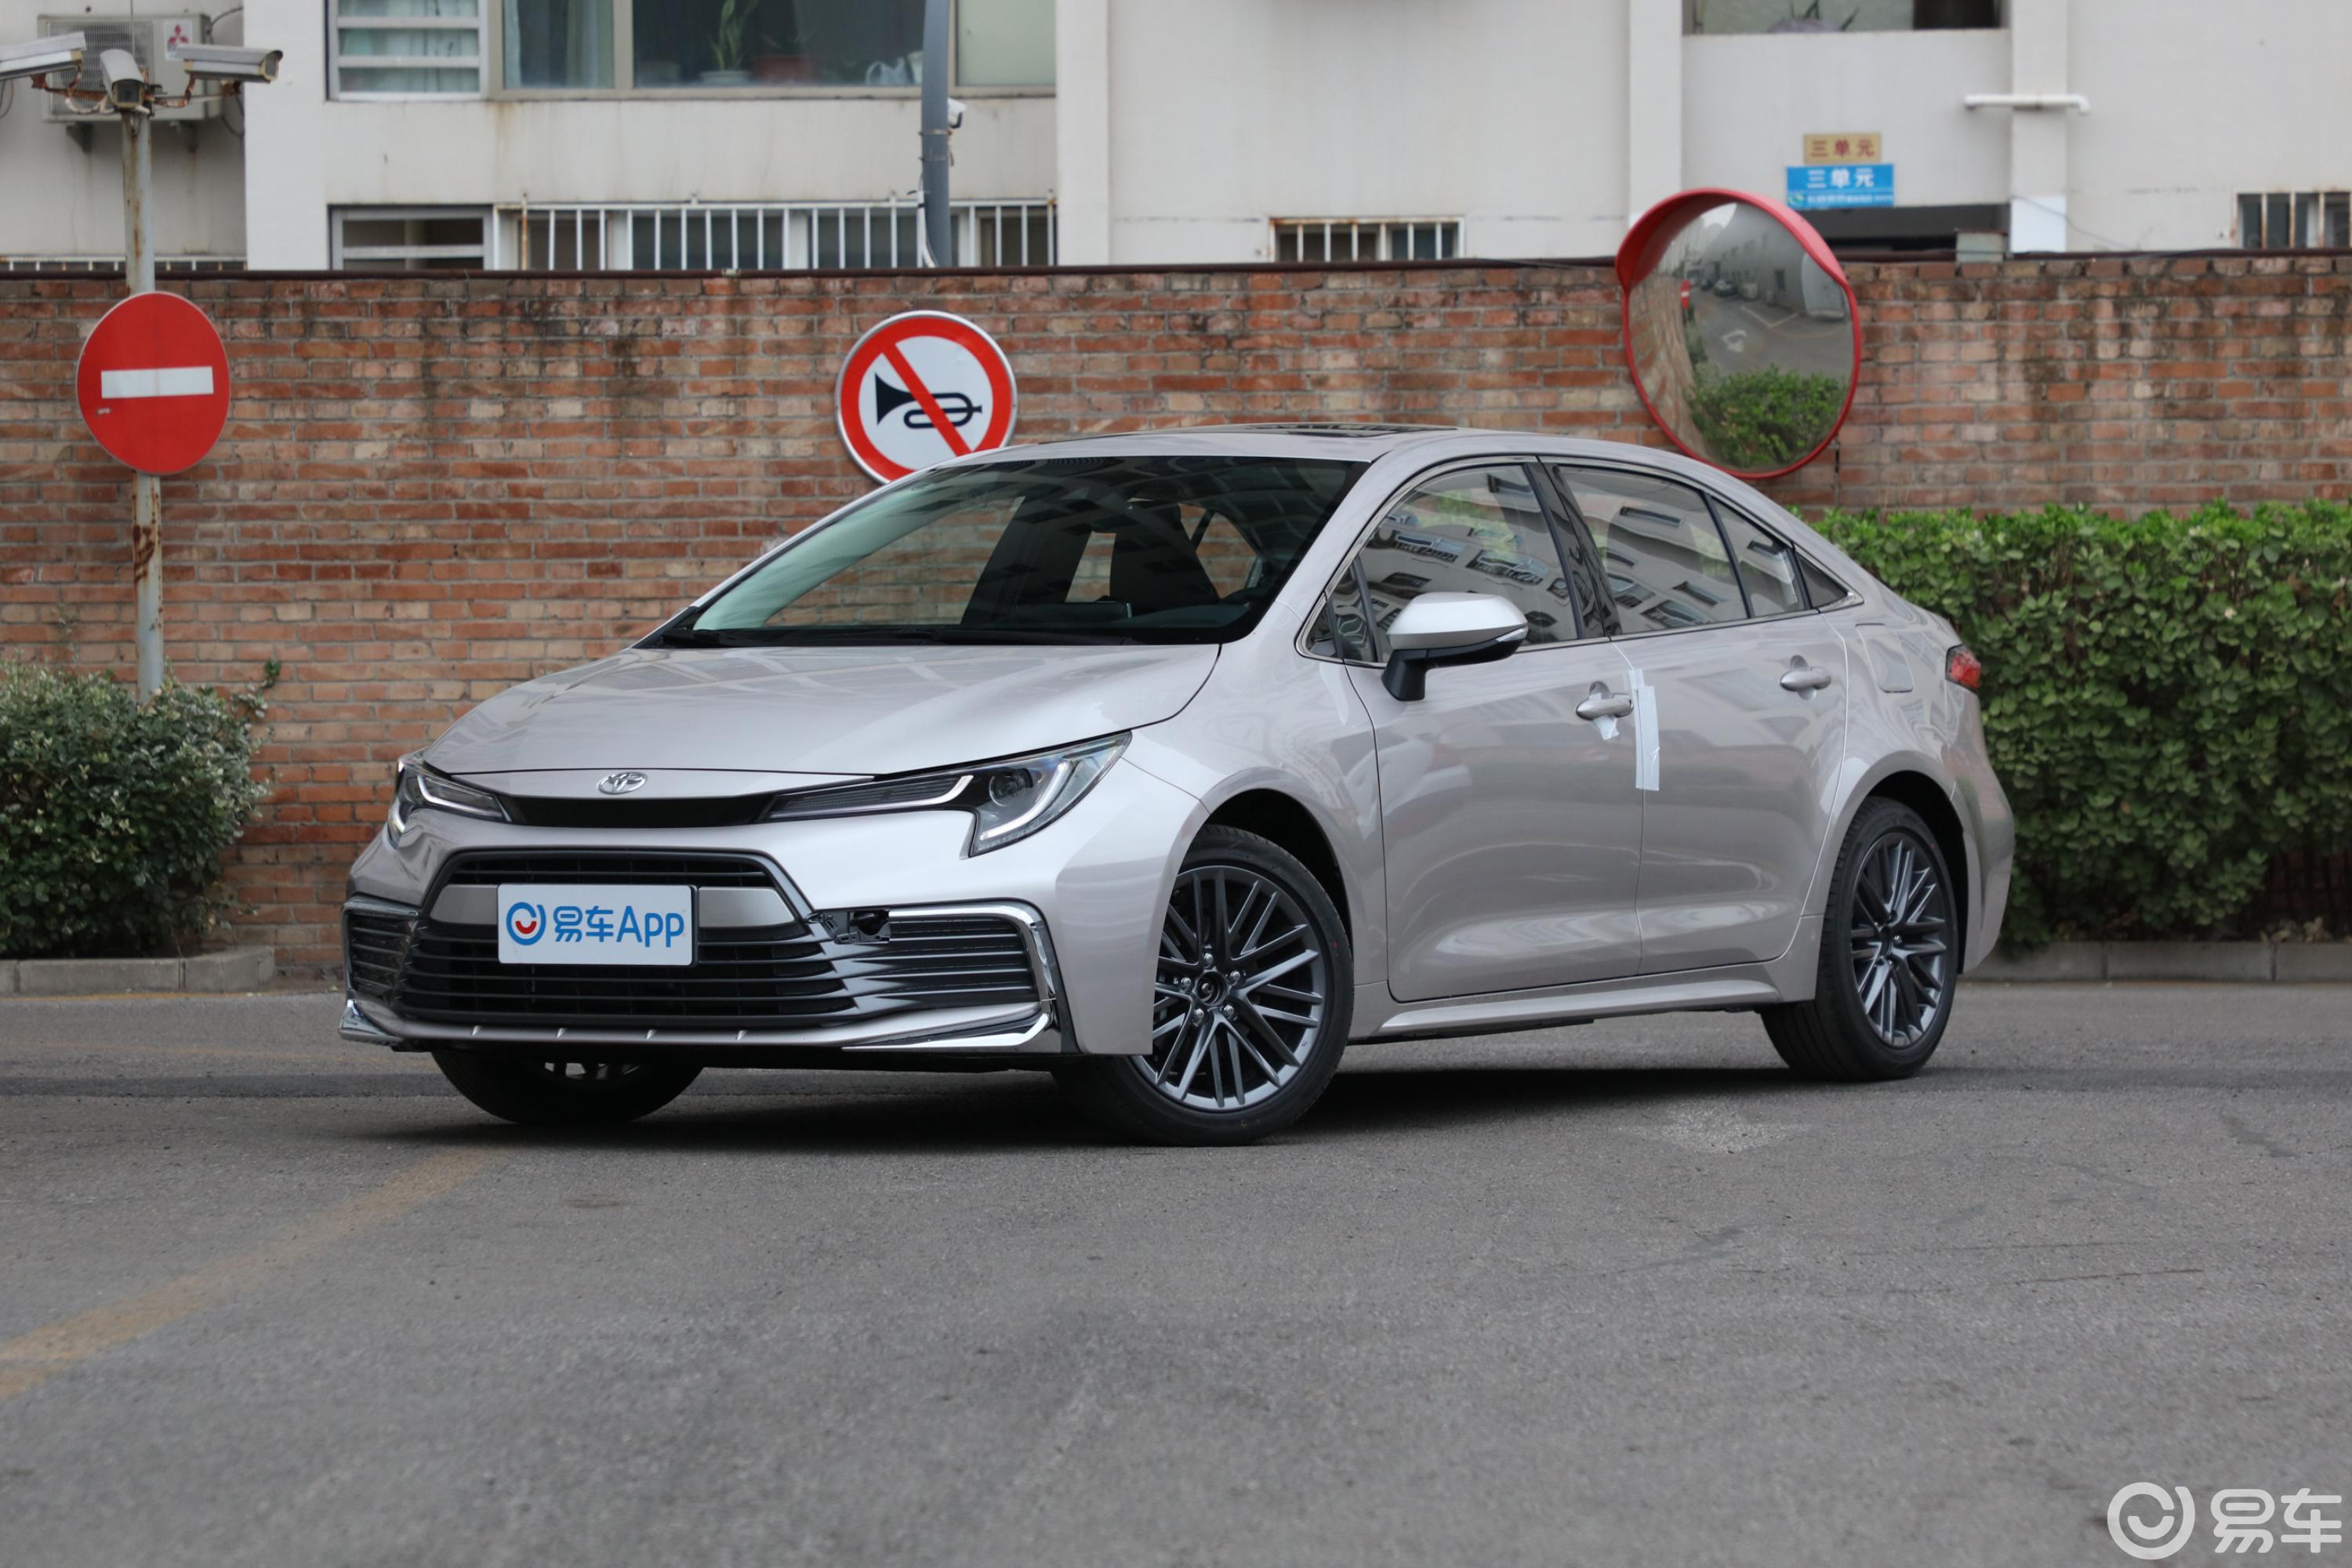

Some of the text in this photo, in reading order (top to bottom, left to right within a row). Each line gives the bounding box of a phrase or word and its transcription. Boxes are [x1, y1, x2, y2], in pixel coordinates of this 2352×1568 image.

[1811, 139, 1875, 158] 三单元
[1807, 168, 1874, 188] 三单元
[553, 906, 684, 948] 易车App
